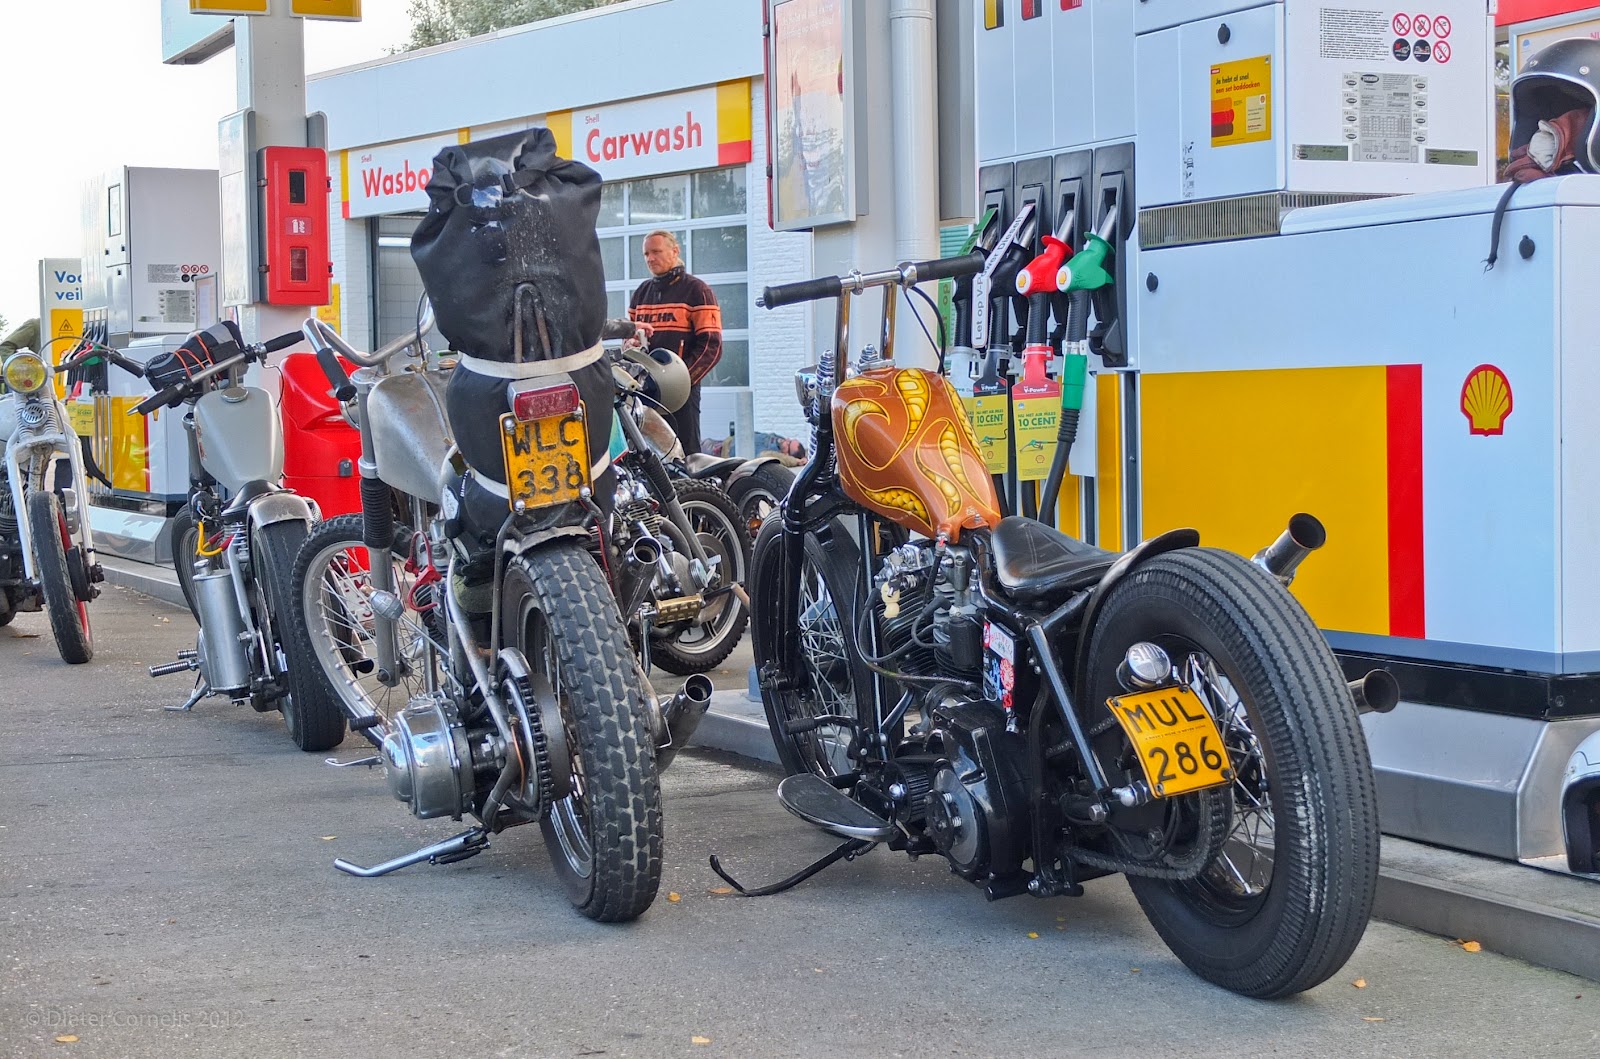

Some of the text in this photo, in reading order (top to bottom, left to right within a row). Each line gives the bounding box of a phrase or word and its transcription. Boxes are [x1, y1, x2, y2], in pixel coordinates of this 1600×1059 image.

[1221, 75, 1233, 83] hebt
[1239, 73, 1249, 81] snel
[1233, 81, 1261, 91] baddoeken
[584, 113, 600, 125] Shell
[586, 111, 703, 163] Carwash
[360, 154, 373, 164] Shell
[361, 160, 434, 198] Wasbo
[975, 215, 1023, 341] Let op V-Power Diesel!
[637, 312, 677, 323] RICHA
[976, 415, 985, 424] 10
[985, 414, 1004, 423] CENT
[1018, 416, 1057, 427] 10 CENT
[510, 416, 580, 456] WLC
[518, 460, 584, 499] 338
[1122, 696, 1206, 734] MUL
[1148, 735, 1222, 783] 286
